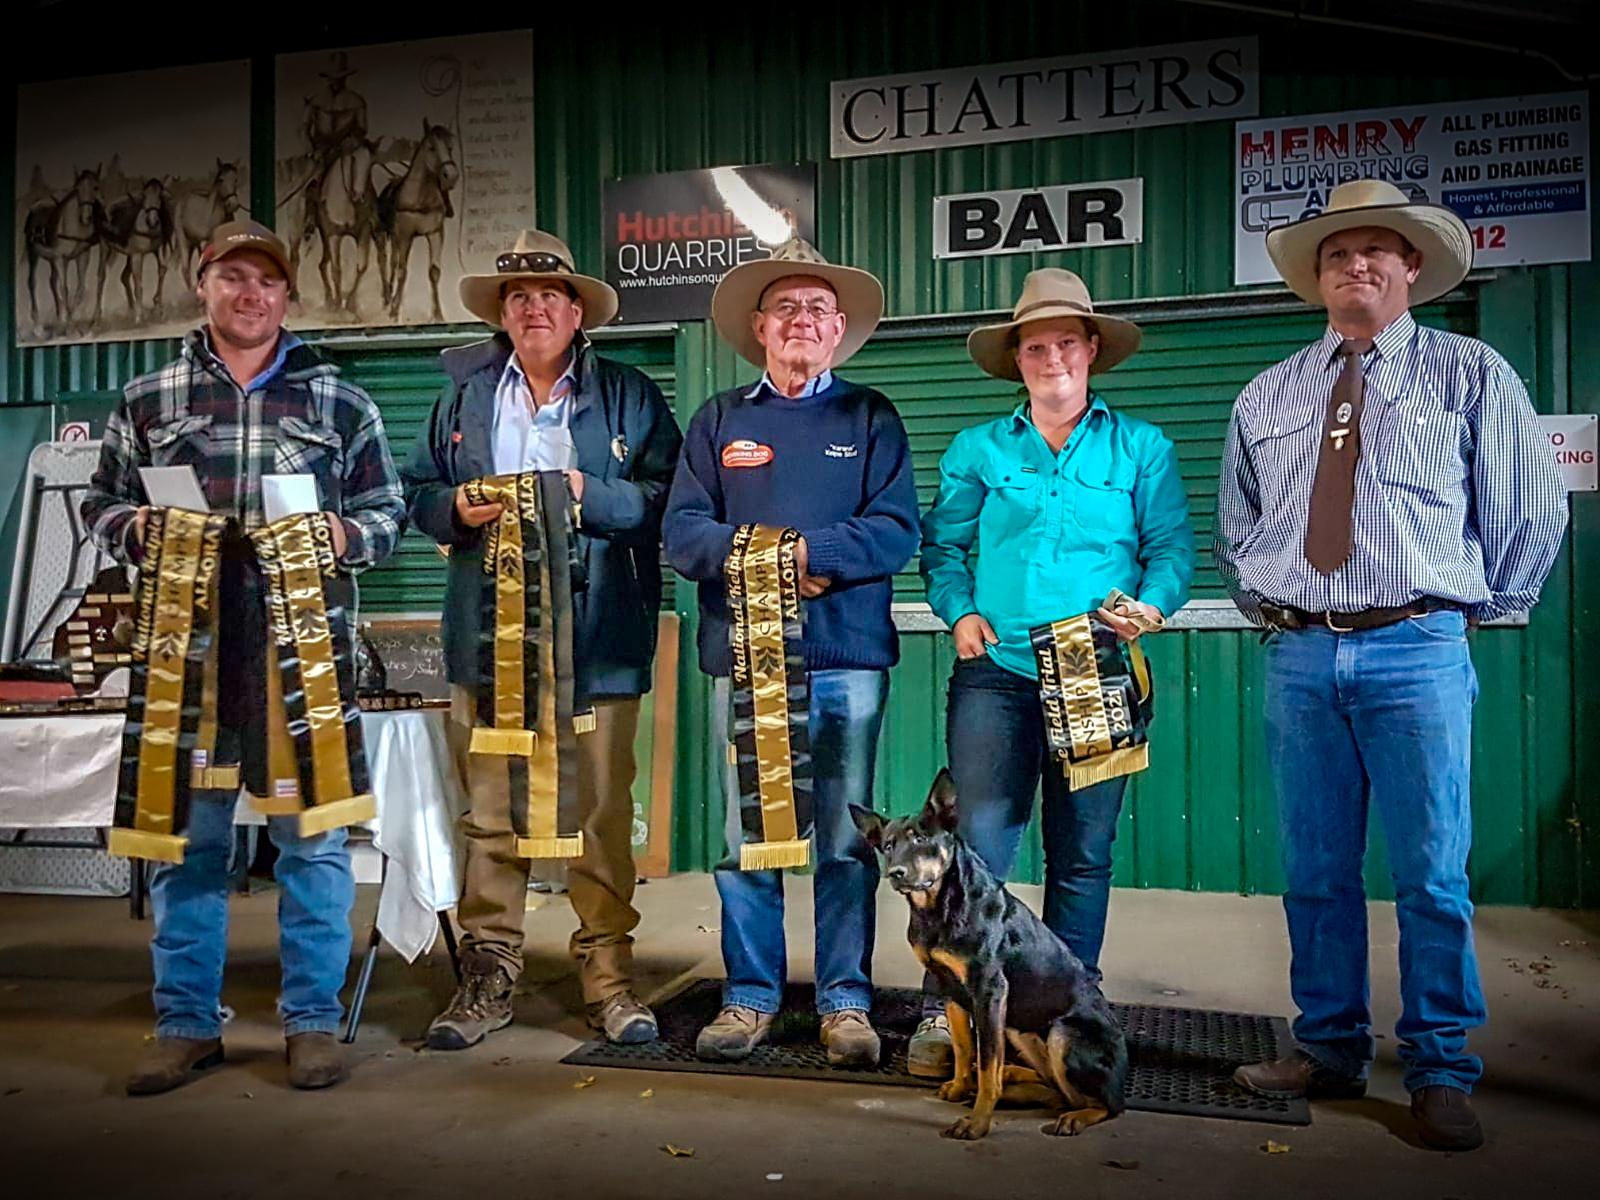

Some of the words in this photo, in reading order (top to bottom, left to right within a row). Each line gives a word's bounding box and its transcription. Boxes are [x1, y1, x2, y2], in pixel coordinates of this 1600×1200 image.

[842, 49, 1245, 145] CHATTERS
[1440, 113, 1476, 134] ALL
[1481, 104, 1582, 131] PLUMBING
[1240, 115, 1428, 169] HENRY
[1454, 137, 1492, 157] GAS
[1498, 131, 1569, 154] FITTING
[1240, 155, 1430, 195] PLUMBING
[1440, 165, 1481, 184] AND
[1486, 155, 1584, 180] DRAINAGE
[1449, 190, 1495, 205] Honest,
[1501, 183, 1580, 200] Professional
[948, 187, 1125, 254] BAR
[1473, 204, 1483, 215] &
[1485, 198, 1555, 214] Affordable
[618, 236, 773, 276] QUARRIES
[519, 472, 536, 522] ALLO
[311, 512, 339, 579] ALLOR
[733, 523, 750, 547] Fie
[194, 528, 221, 611] ALLORA
[727, 546, 743, 599] Kelpie
[781, 541, 798, 620] ALLORA
[131, 576, 155, 661] National
[731, 602, 747, 684] National
[1038, 647, 1056, 694] Trial
[1046, 696, 1066, 745] Field
[1108, 688, 1129, 732] 2021
